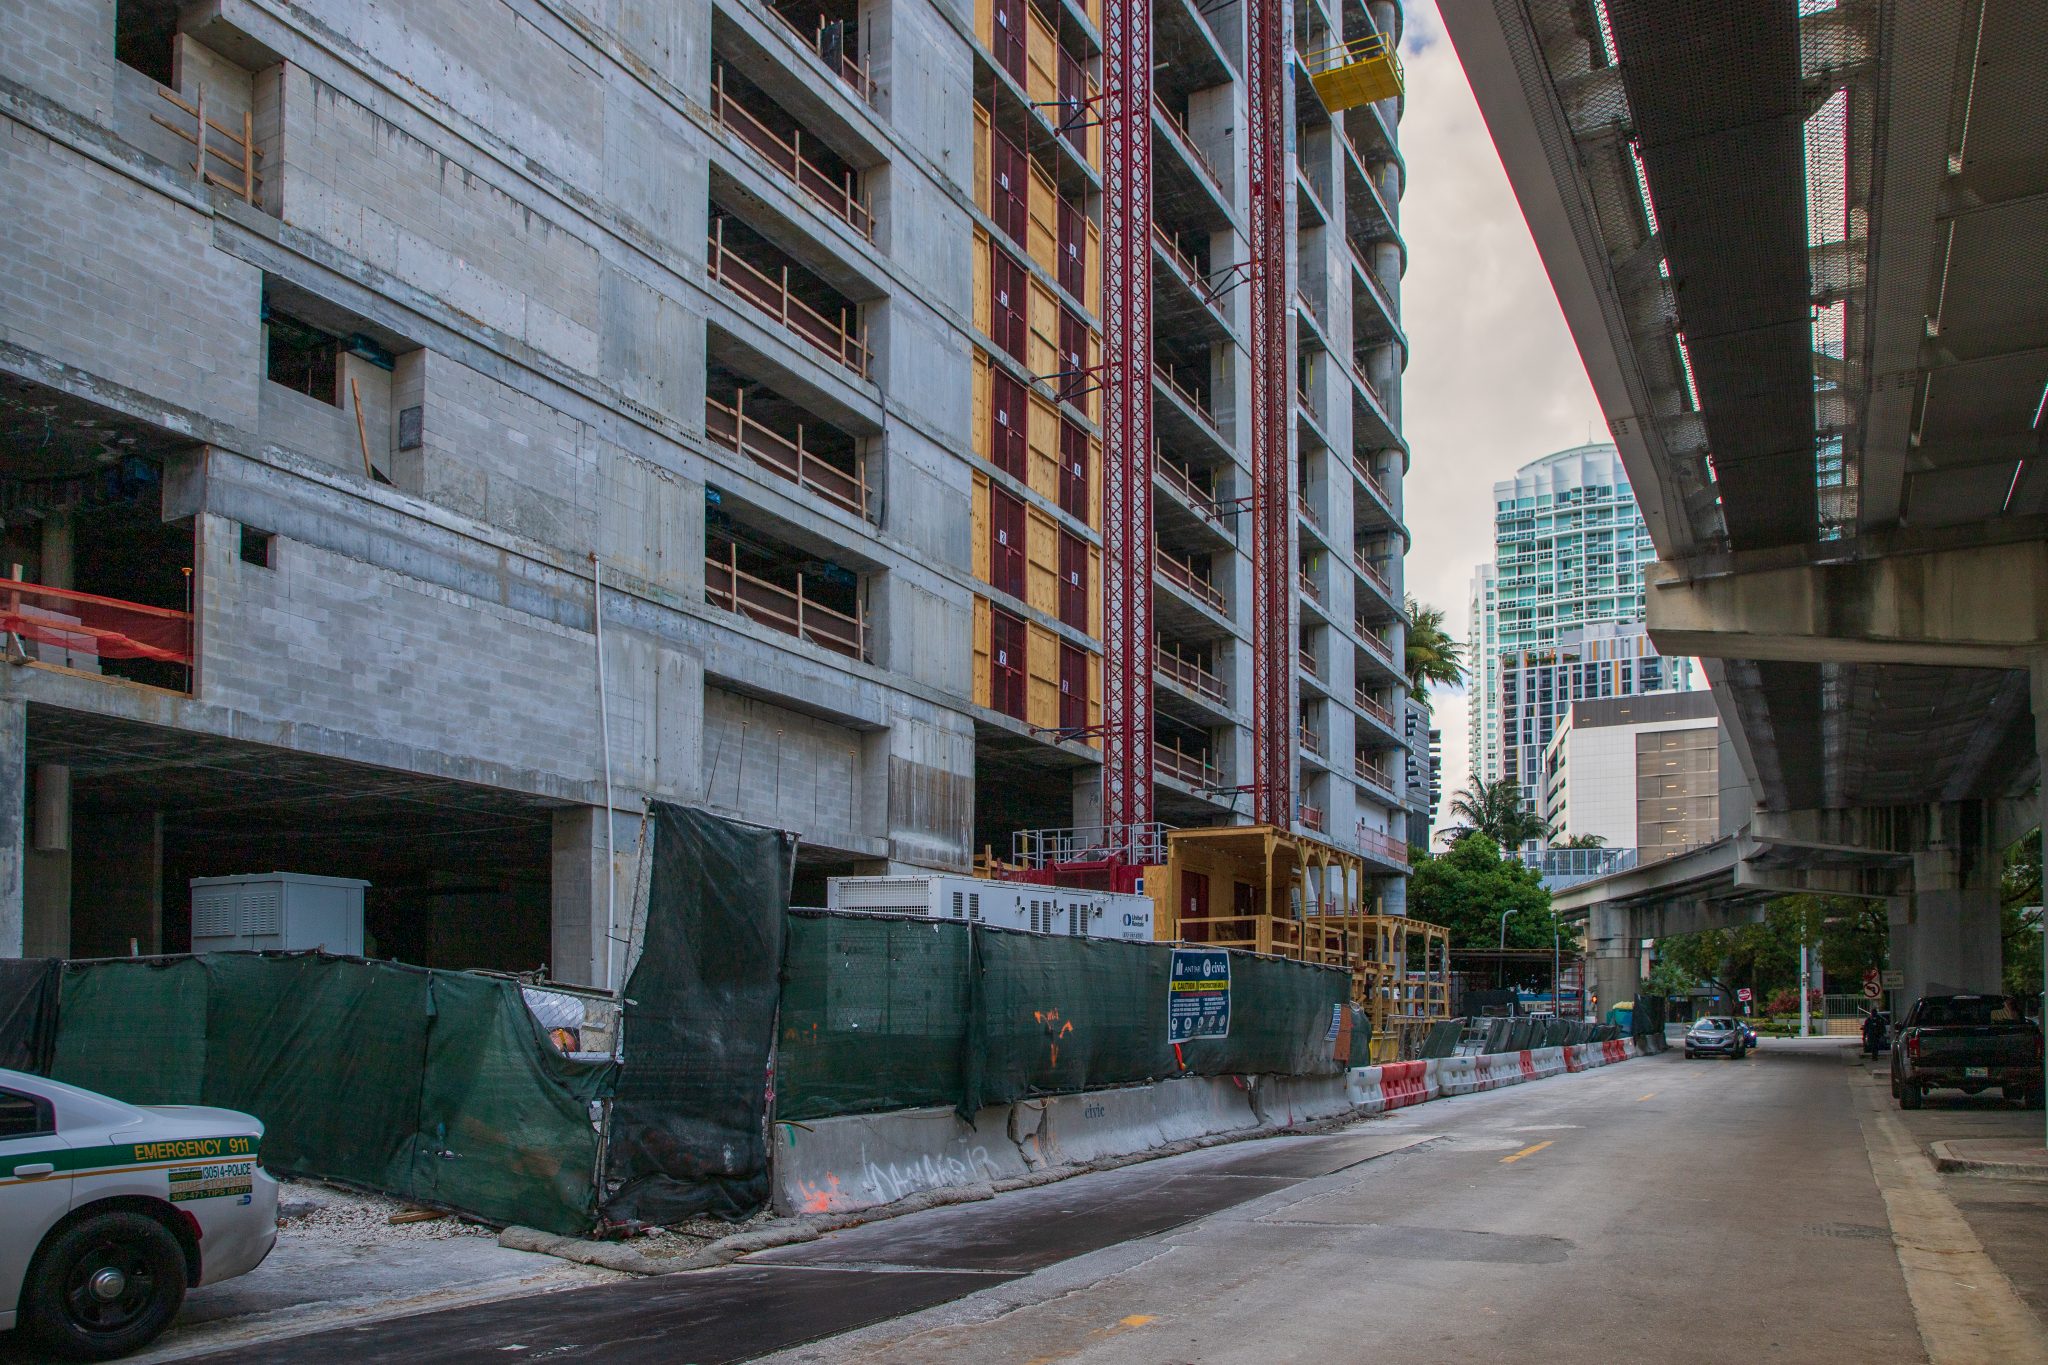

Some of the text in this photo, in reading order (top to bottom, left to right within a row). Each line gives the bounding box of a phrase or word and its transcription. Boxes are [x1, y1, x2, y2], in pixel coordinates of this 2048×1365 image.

[1211, 961, 1226, 973] civic
[1085, 1104, 1105, 1118] civic
[134, 1138, 249, 1160] EMERGENCY 911
